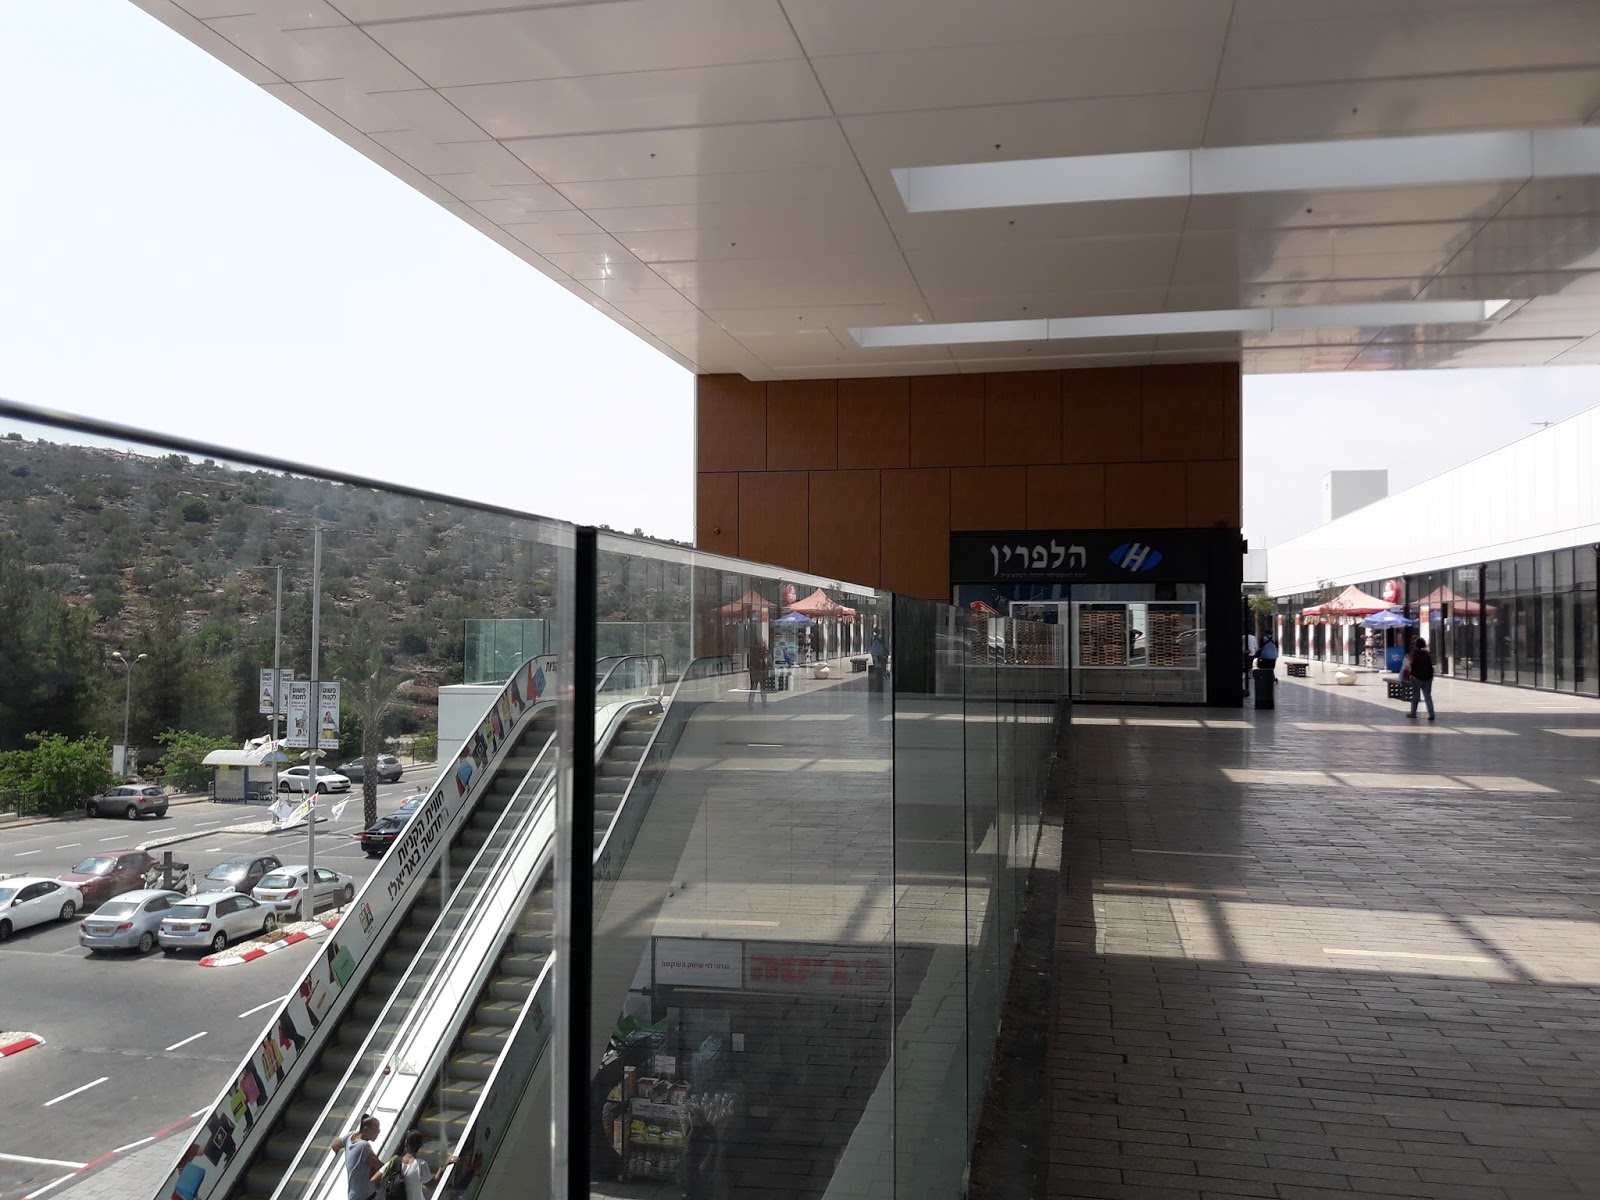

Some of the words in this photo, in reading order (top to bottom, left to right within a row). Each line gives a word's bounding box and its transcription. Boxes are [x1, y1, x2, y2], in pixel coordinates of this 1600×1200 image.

[990, 538, 1087, 577] הלפרין
[420, 805, 449, 853] החדשה
[425, 789, 445, 824] חווית
[397, 818, 425, 866] הקניות
[387, 848, 421, 902] באריאל!
